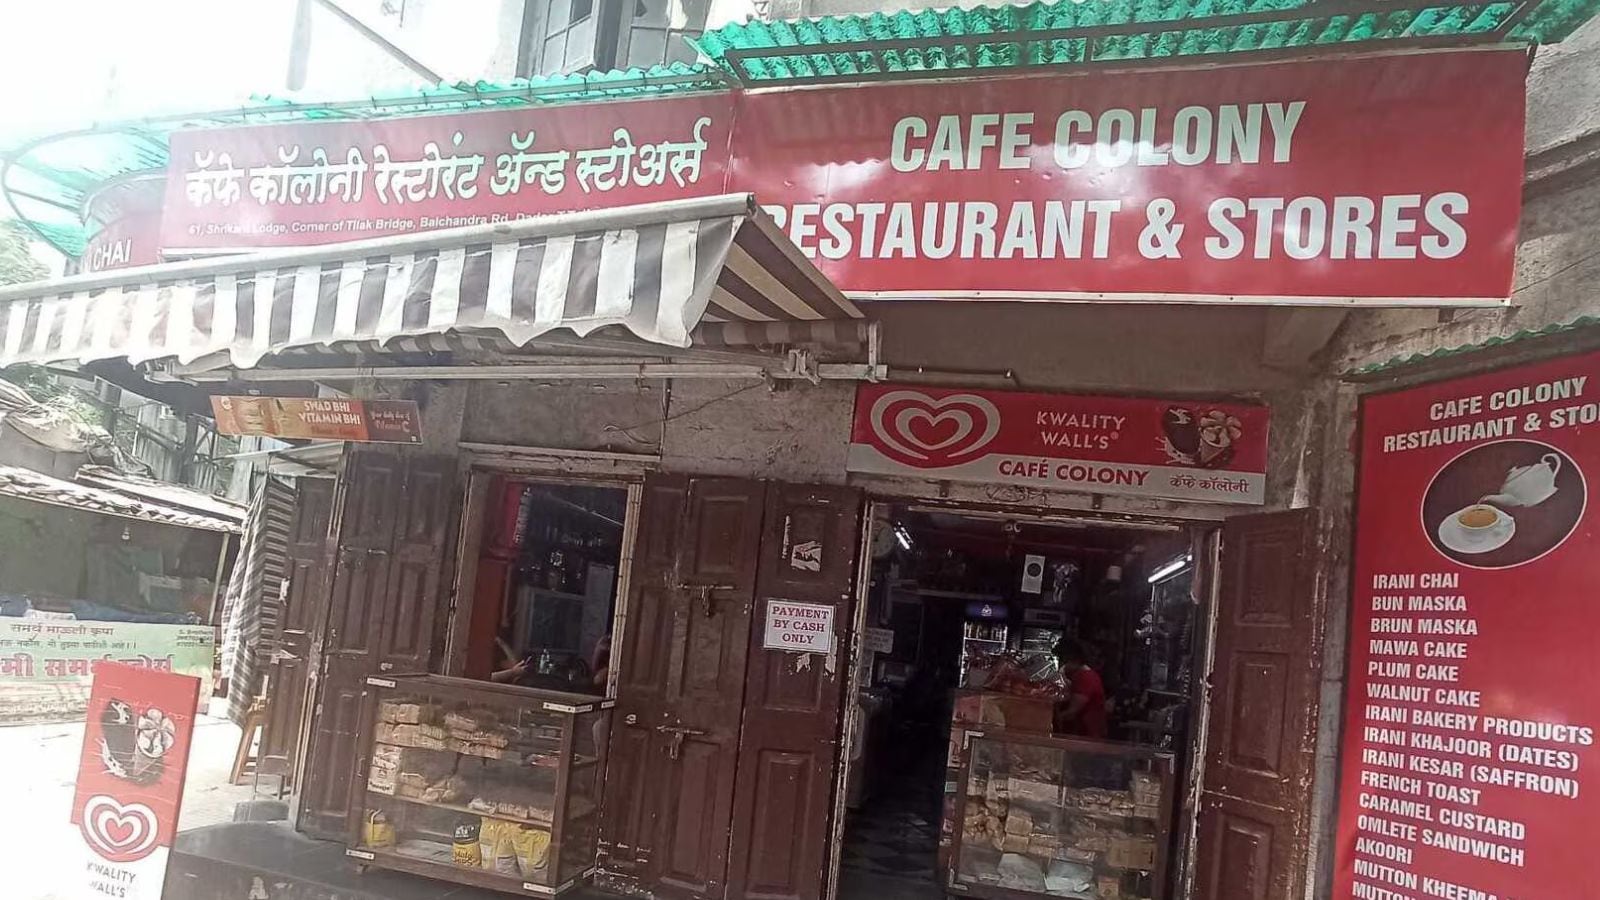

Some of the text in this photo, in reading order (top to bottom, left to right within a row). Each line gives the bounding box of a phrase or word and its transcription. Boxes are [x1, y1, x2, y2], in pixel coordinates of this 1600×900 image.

[890, 101, 1306, 173] CAFE COLONY
[186, 149, 245, 207] कॅफे
[249, 146, 368, 206] कॉलोनी
[374, 130, 484, 203] रेस्टोरंट
[577, 117, 711, 194] स्टोअर्स
[292, 221, 329, 233] Corner
[332, 221, 345, 232] of
[376, 218, 416, 232] Bridge,
[1138, 197, 1185, 260] &
[1204, 192, 1470, 261] STORES
[93, 239, 132, 270] CHAI
[333, 402, 350, 412] BHI
[1430, 376, 1587, 421] CAFE COLONY
[299, 413, 361, 424] VITAMIN BHI
[402, 420, 411, 432] C
[1036, 410, 1127, 429] KWALITY
[1383, 403, 1600, 452] RESTAURANT & STO
[999, 457, 1150, 486] CAFÉ COLONY
[1199, 475, 1250, 493] कॉलोनी
[1373, 573, 1459, 589] IRANI CHAI
[772, 606, 829, 619] PAYMENT
[1372, 595, 1467, 611] BUN MASKA
[774, 619, 825, 632] BY CASH
[1370, 618, 1478, 635] BRUN MASKA
[782, 633, 814, 644] ONLY
[1369, 639, 1468, 658] MAWA CAKE
[1368, 661, 1459, 681] PLUM CAKE
[1366, 683, 1480, 707] WALNUT CAKE
[1365, 705, 1593, 745] IRANI BAKERY PRODUCTS
[1364, 727, 1578, 772] IRANI KHAJOOR (DATES)
[1362, 749, 1578, 799] IRANI KESAR (SAFFRON)
[1361, 771, 1481, 805] FRENCH TOAST
[1359, 793, 1525, 841] CARAMEL CUSTARD
[1355, 837, 1412, 865] AKOORI
[1357, 815, 1525, 867] OMLETE SANDWICH
[87, 861, 136, 883] KWALITY
[1353, 859, 1498, 900] MUTTON KHEEMA
[1352, 881, 1416, 900] MUTT
